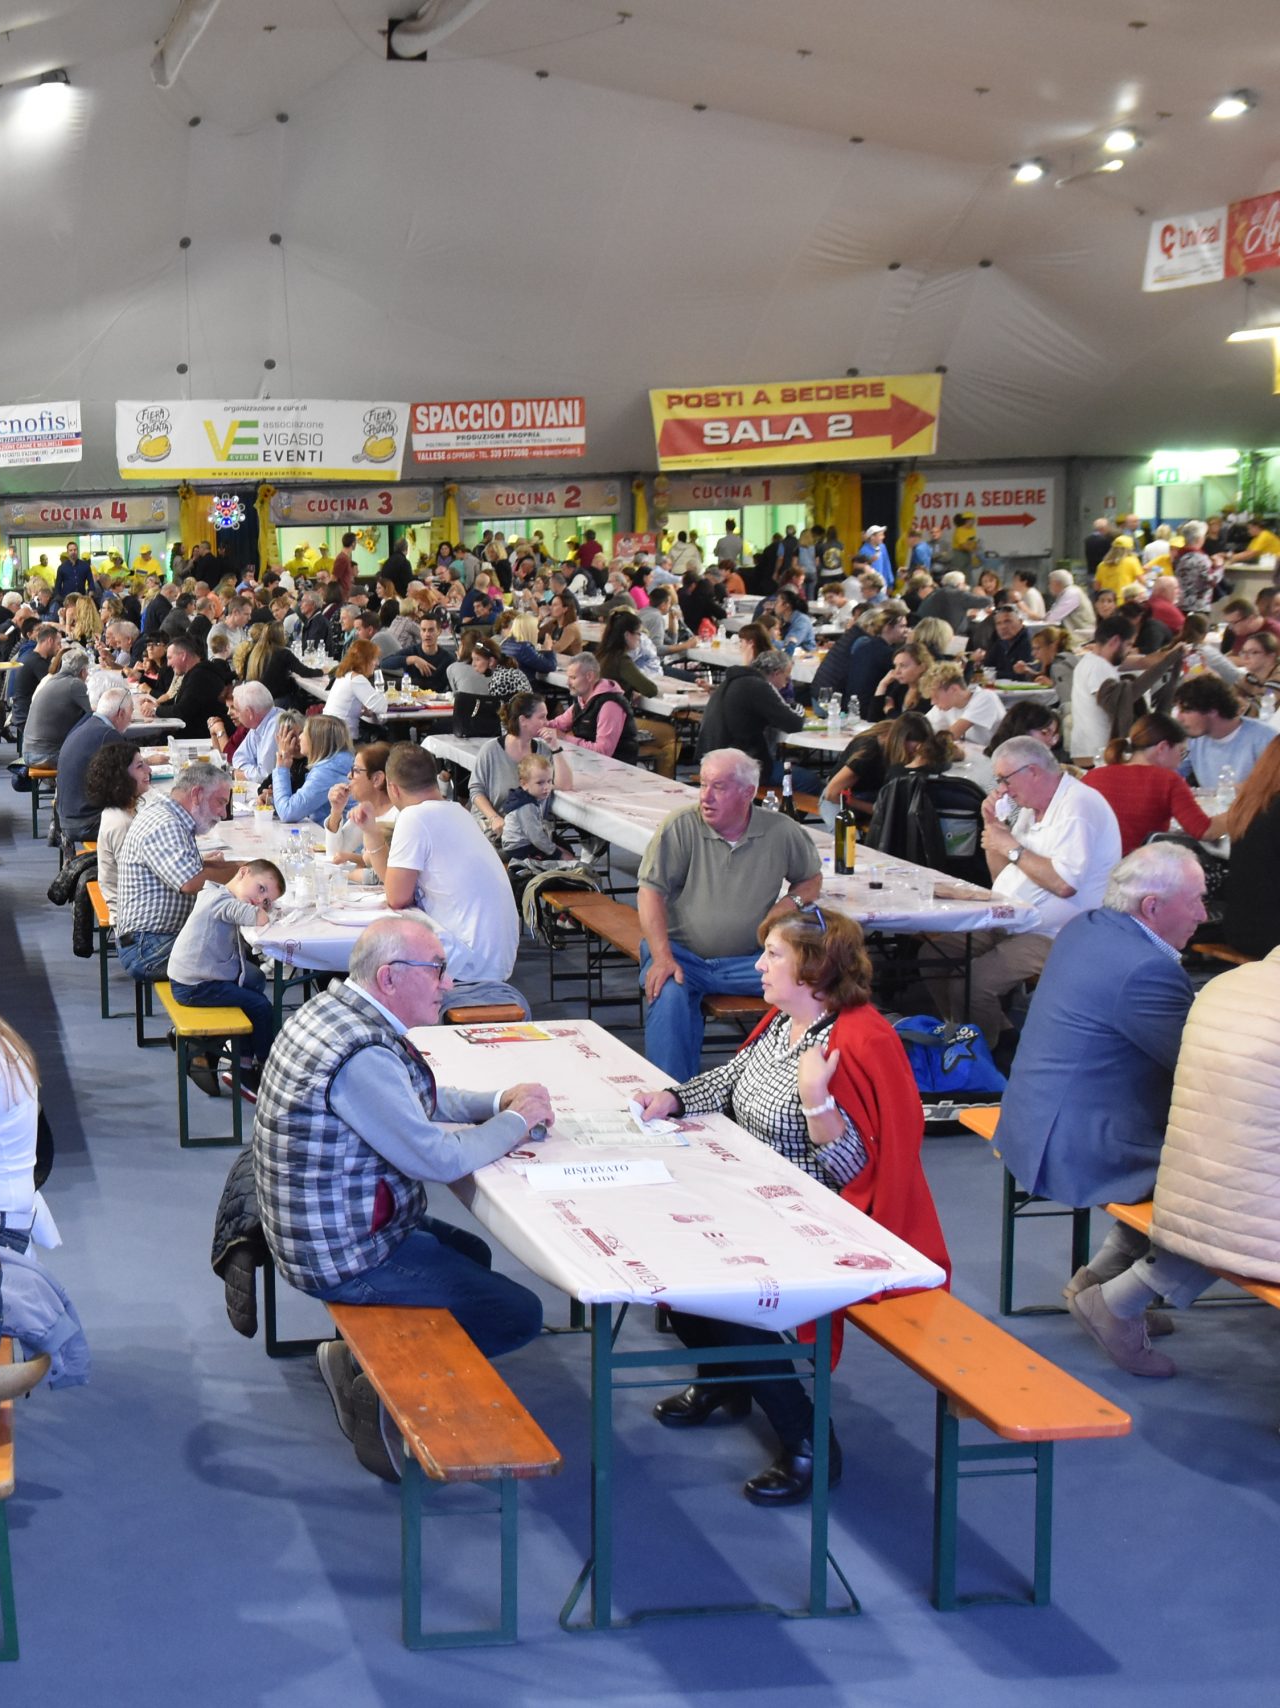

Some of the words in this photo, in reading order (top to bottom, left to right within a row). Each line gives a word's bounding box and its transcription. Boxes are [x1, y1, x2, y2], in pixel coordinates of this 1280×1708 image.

[667, 391, 744, 410] POSTI
[753, 389, 772, 405] A
[780, 383, 886, 404] SEDERE
[141, 408, 166, 420] FIERA
[224, 405, 275, 413] organizzazione
[415, 403, 506, 432] SPACCIO
[511, 400, 581, 427] DIVANI
[263, 420, 324, 429] associazione
[703, 416, 814, 446] SALA
[827, 414, 855, 438] 2
[263, 433, 323, 446] VIGASIO
[456, 432, 505, 441] PRODUZIONE
[508, 431, 540, 439] PROPRIA
[263, 450, 323, 462] EVENTI
[417, 451, 446, 460] VALLESE
[495, 492, 556, 507] CUCINA
[563, 485, 582, 508] 2
[692, 484, 753, 499] CUCINA
[762, 479, 772, 502] 1
[964, 491, 977, 507] A
[981, 488, 1047, 507] SEDERE
[307, 498, 369, 513] CUCINA
[377, 492, 394, 515] 3
[40, 506, 103, 522] CUCINA
[110, 501, 128, 523] 4
[563, 1164, 630, 1176] RISERVATO
